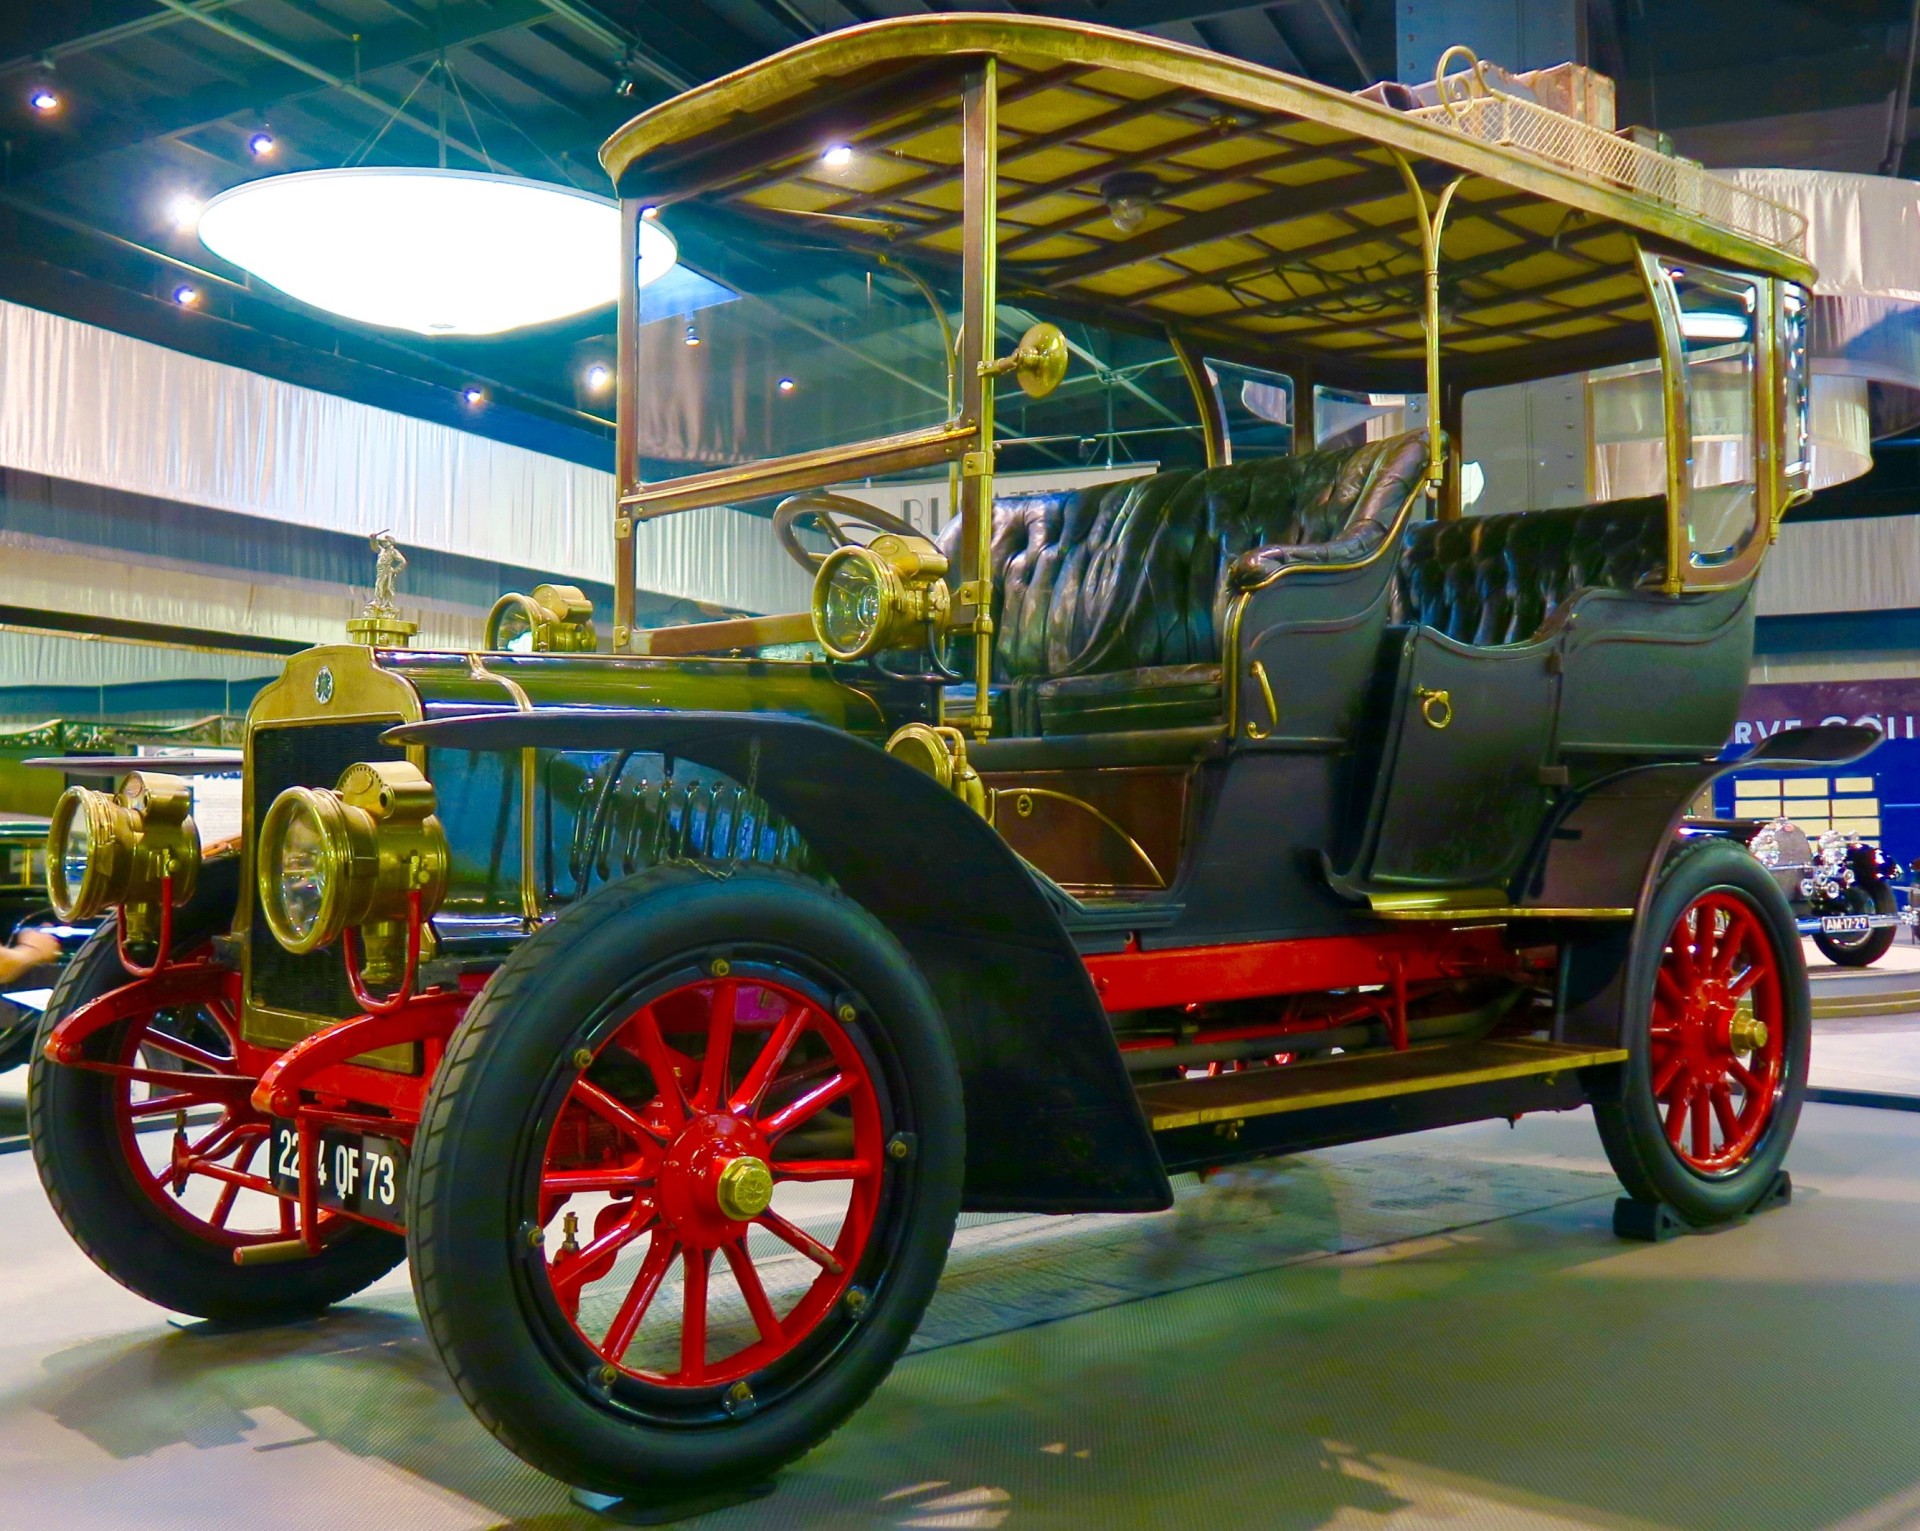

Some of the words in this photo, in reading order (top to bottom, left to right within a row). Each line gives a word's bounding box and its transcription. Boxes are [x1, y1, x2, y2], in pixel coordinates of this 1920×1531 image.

[278, 1129, 327, 1186] 224
[335, 1144, 359, 1200] QF
[365, 1151, 395, 1205] 73
